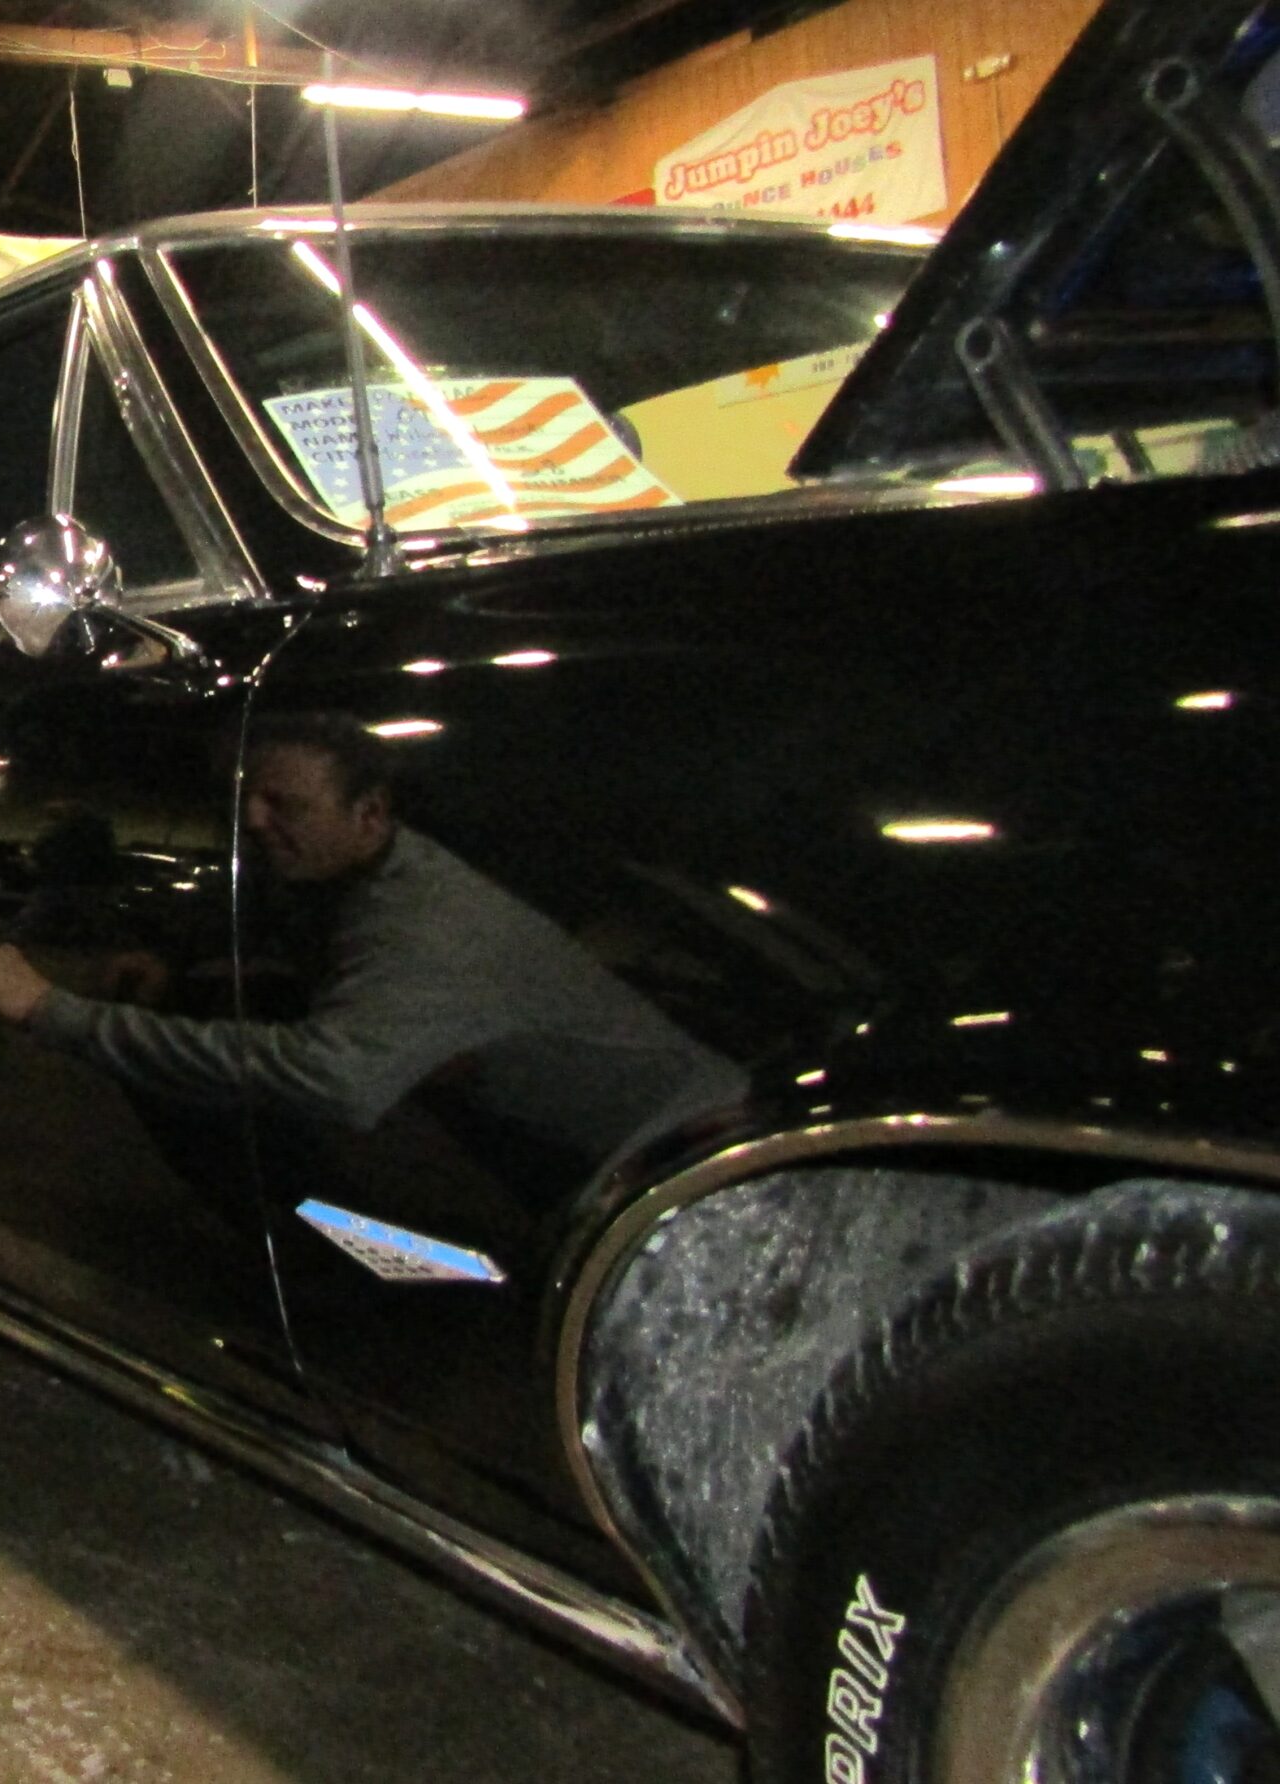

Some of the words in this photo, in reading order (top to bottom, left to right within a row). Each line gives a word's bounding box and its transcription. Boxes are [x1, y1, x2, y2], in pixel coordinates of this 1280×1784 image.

[665, 129, 799, 200] Jumpin
[804, 78, 926, 152] Joey's
[801, 142, 902, 186] HOUSES
[303, 432, 360, 447] NAM
